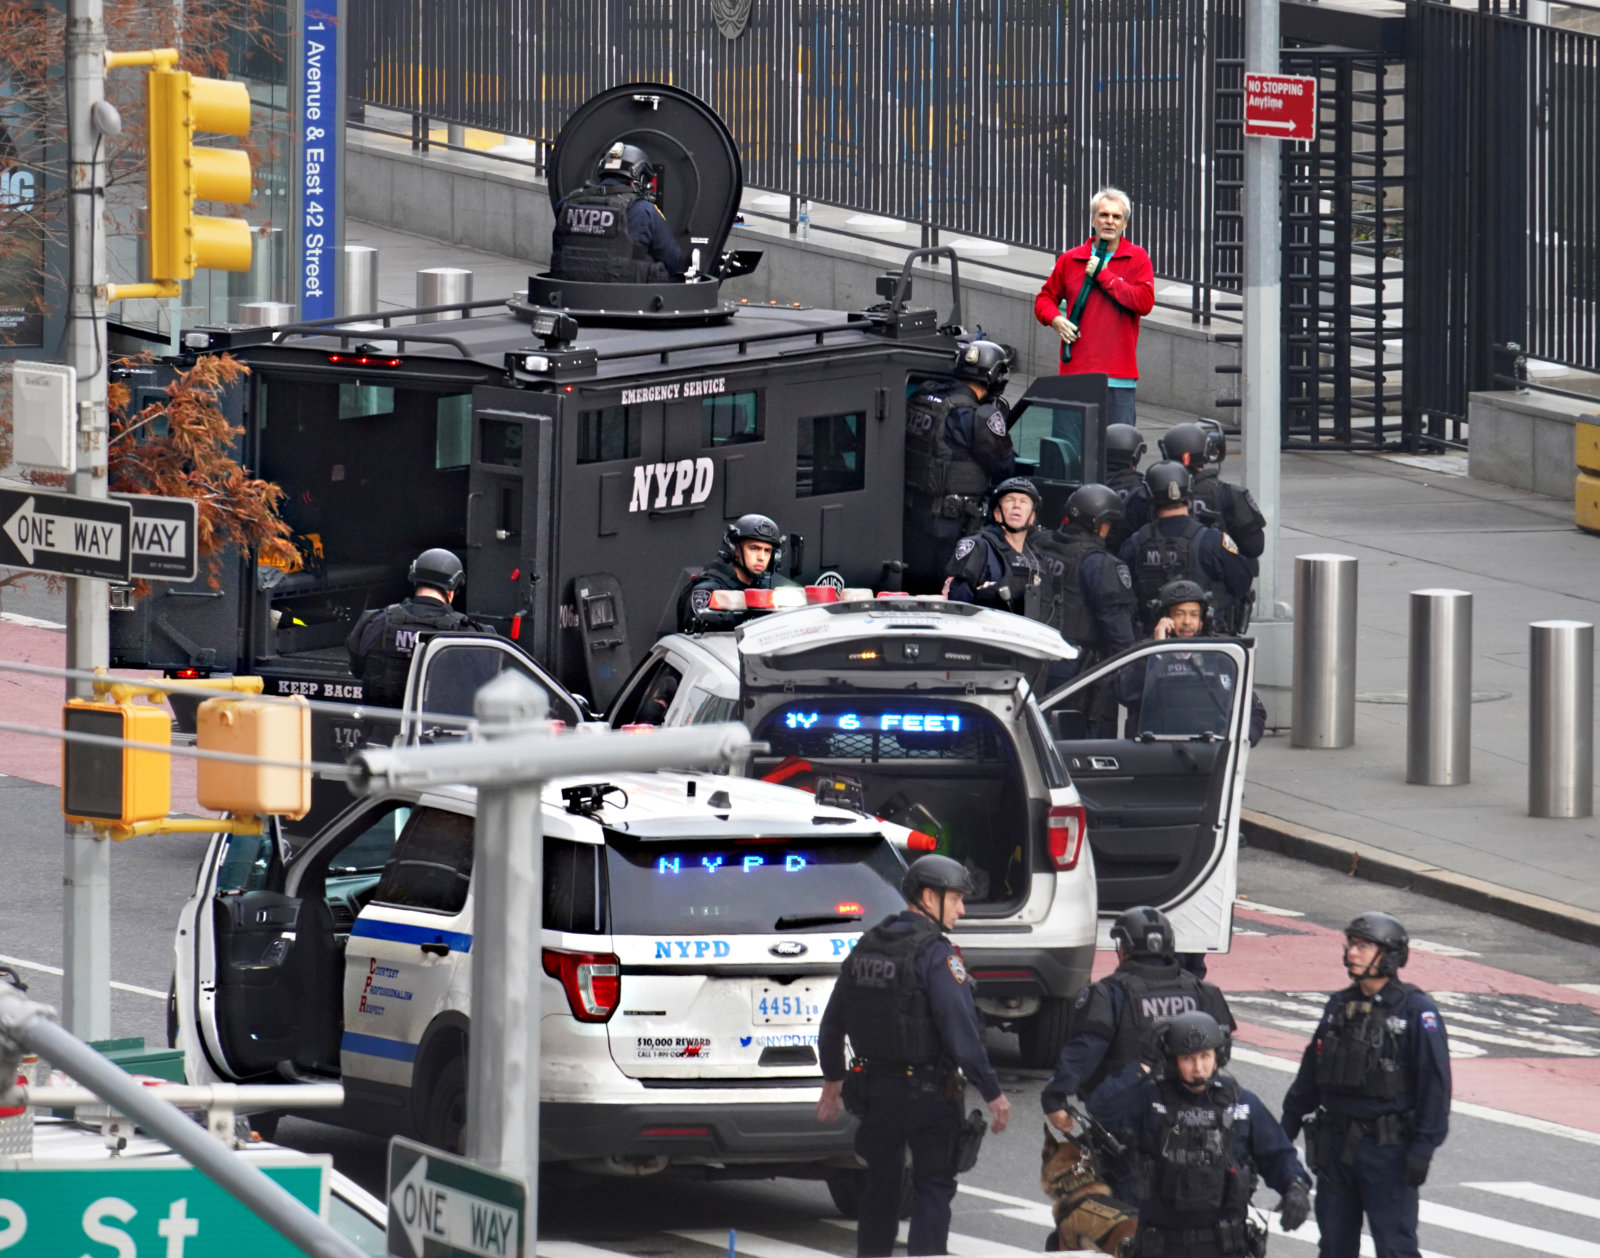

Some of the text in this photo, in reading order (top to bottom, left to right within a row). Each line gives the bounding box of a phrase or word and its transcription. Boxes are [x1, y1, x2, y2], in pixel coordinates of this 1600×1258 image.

[306, 40, 326, 120] Avenue
[1248, 80, 1303, 96] NO STOPPING
[1248, 94, 1283, 109] Anytime
[306, 126, 325, 141] &
[306, 148, 324, 195] East
[306, 201, 324, 227] 42
[567, 208, 614, 227] NYPD
[305, 234, 324, 298] Street
[621, 378, 726, 405] EMERGENCY SERVICE
[629, 457, 714, 512] NYPD
[18, 515, 114, 555] ONE WAY
[132, 522, 179, 552] WAY
[1146, 550, 1177, 565] NYD
[278, 680, 363, 699] KEEP BACK
[838, 713, 861, 730] 6
[655, 939, 730, 959] NYPD
[851, 957, 896, 979] NYPD
[758, 997, 818, 1015] 4451 18
[1141, 996, 1197, 1017] NYPD
[637, 1037, 711, 1049] $10,000 REWARD
[1177, 1109, 1215, 1120] POLICE
[80, 1196, 199, 1258] St
[404, 1181, 513, 1255] ONE WAY
